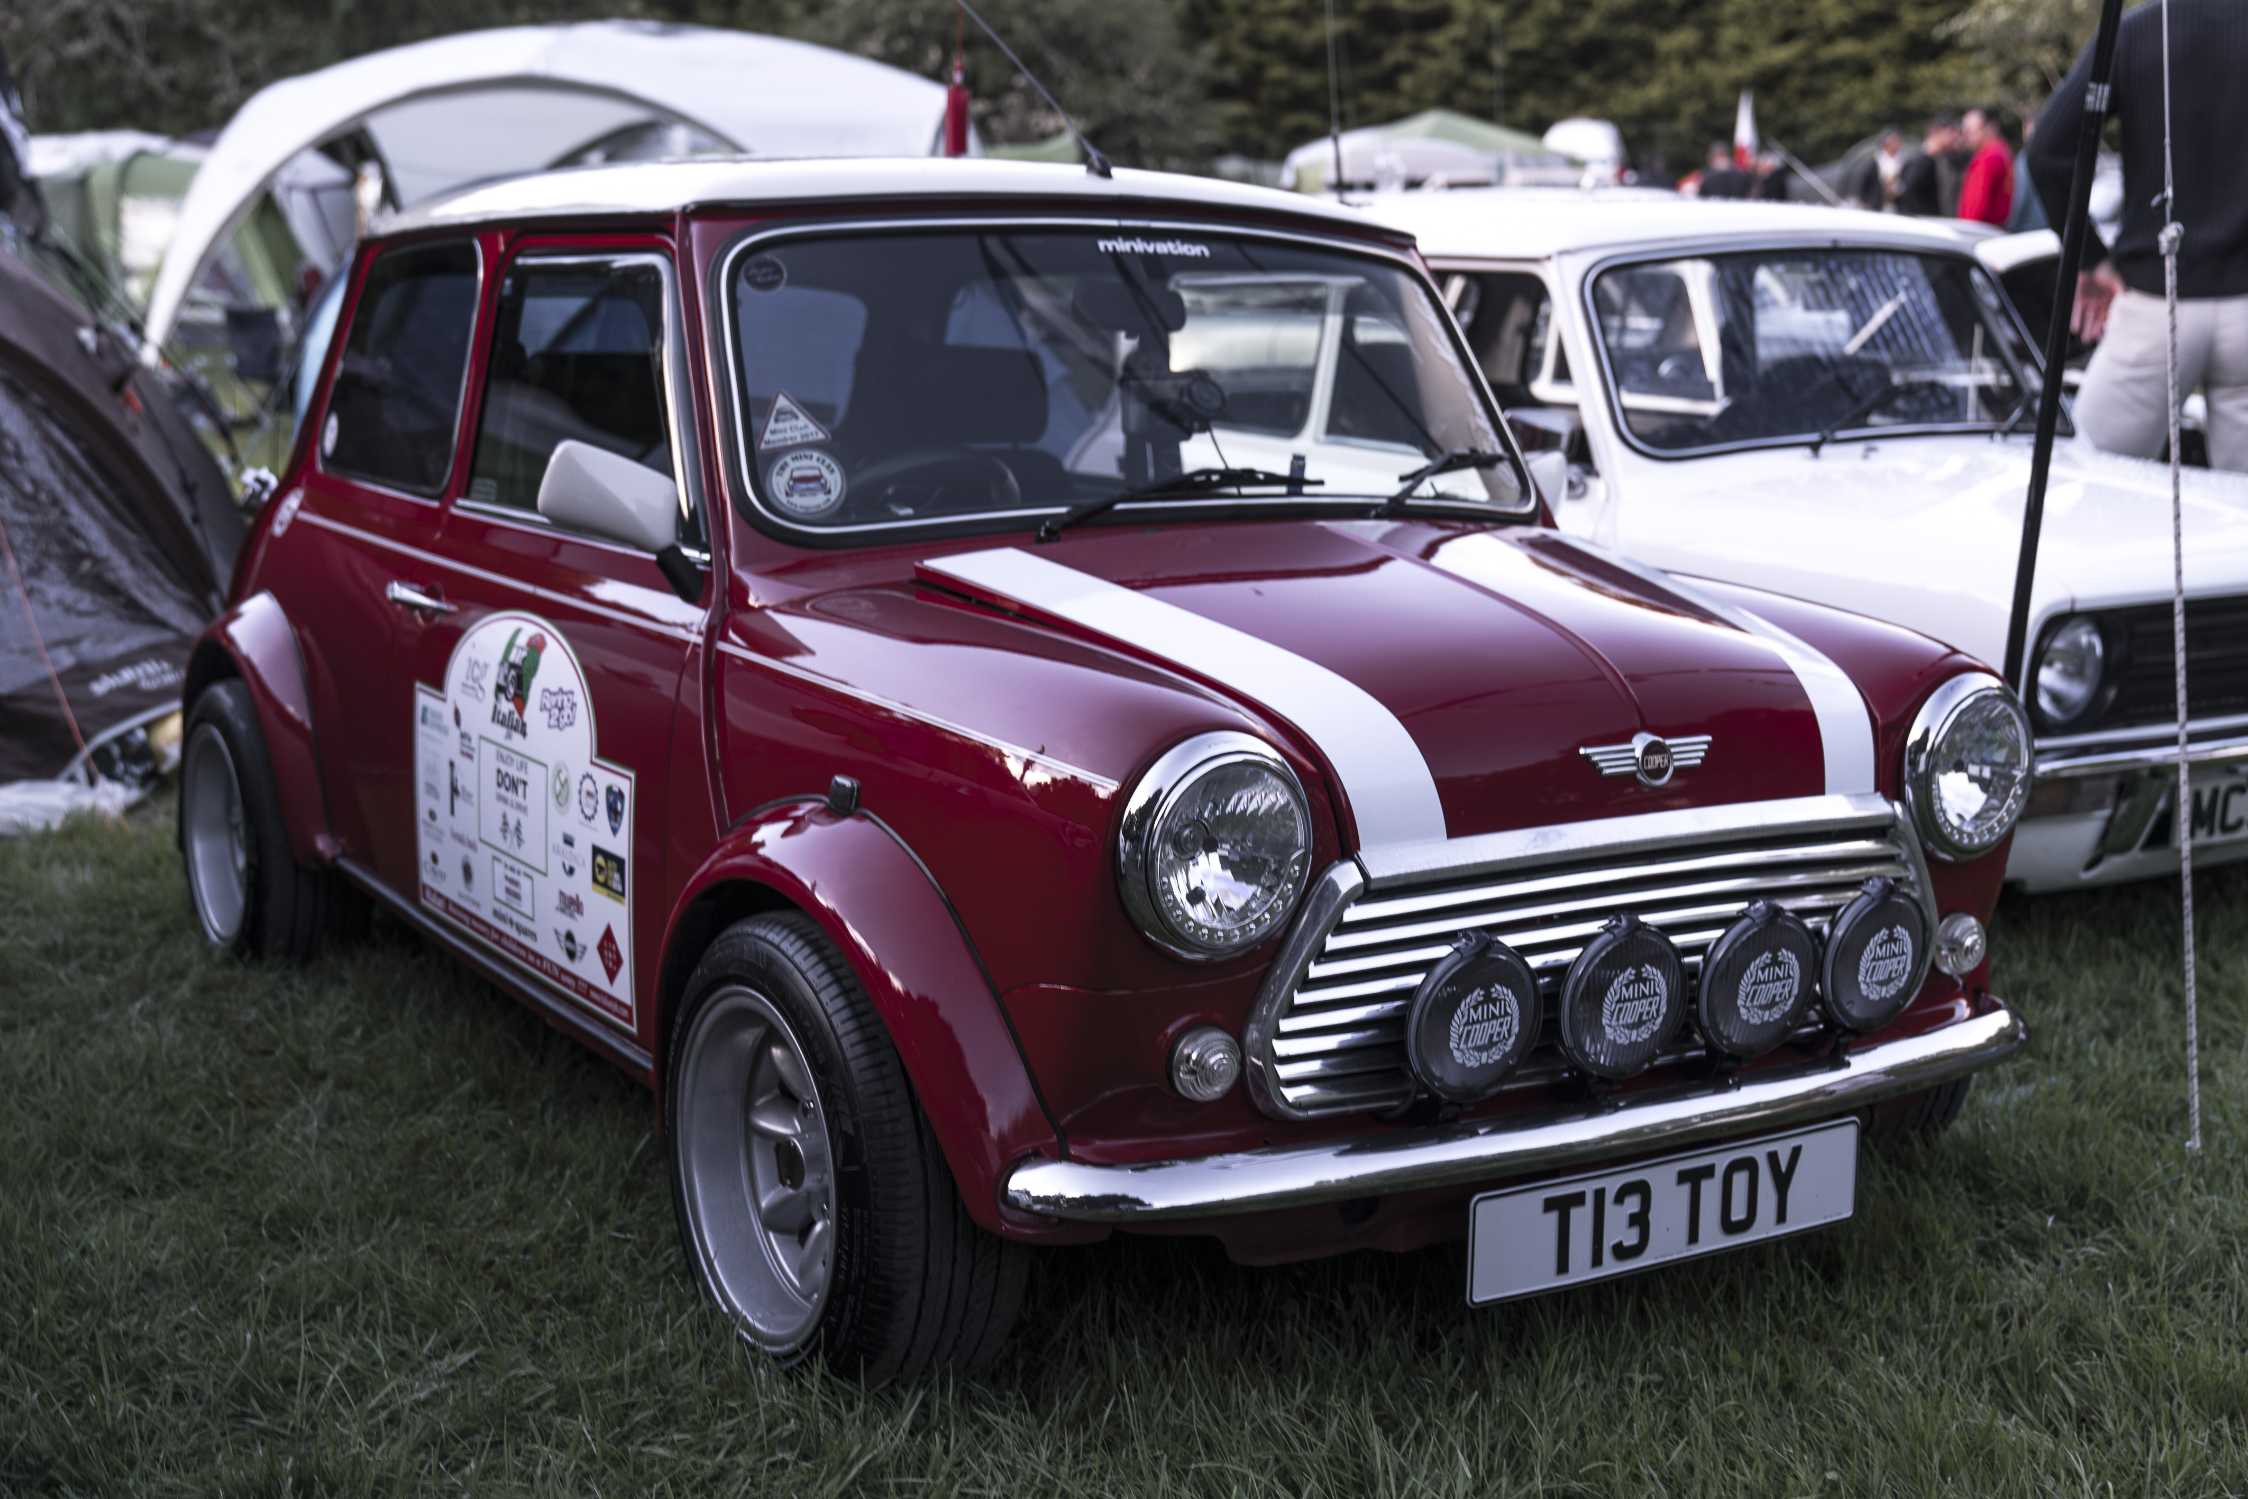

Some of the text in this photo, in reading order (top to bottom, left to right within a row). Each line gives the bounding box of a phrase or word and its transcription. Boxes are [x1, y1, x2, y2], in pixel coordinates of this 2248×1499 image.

[1097, 237, 1211, 258] minivation
[491, 703, 528, 740] Italian
[1643, 752, 1670, 770] COOPER
[496, 767, 529, 801] DON'T
[1875, 938, 1904, 960] MINI
[1756, 962, 1789, 984] MINI
[1865, 954, 1907, 983] COOPER
[1621, 979, 1655, 1002] MINI
[1745, 978, 1793, 1008] COOPER
[1469, 999, 1505, 1023] MINI
[1611, 995, 1661, 1027] COOPER
[1459, 1015, 1512, 1051] COOPER
[1543, 1144, 1804, 1276] T13 TOY
